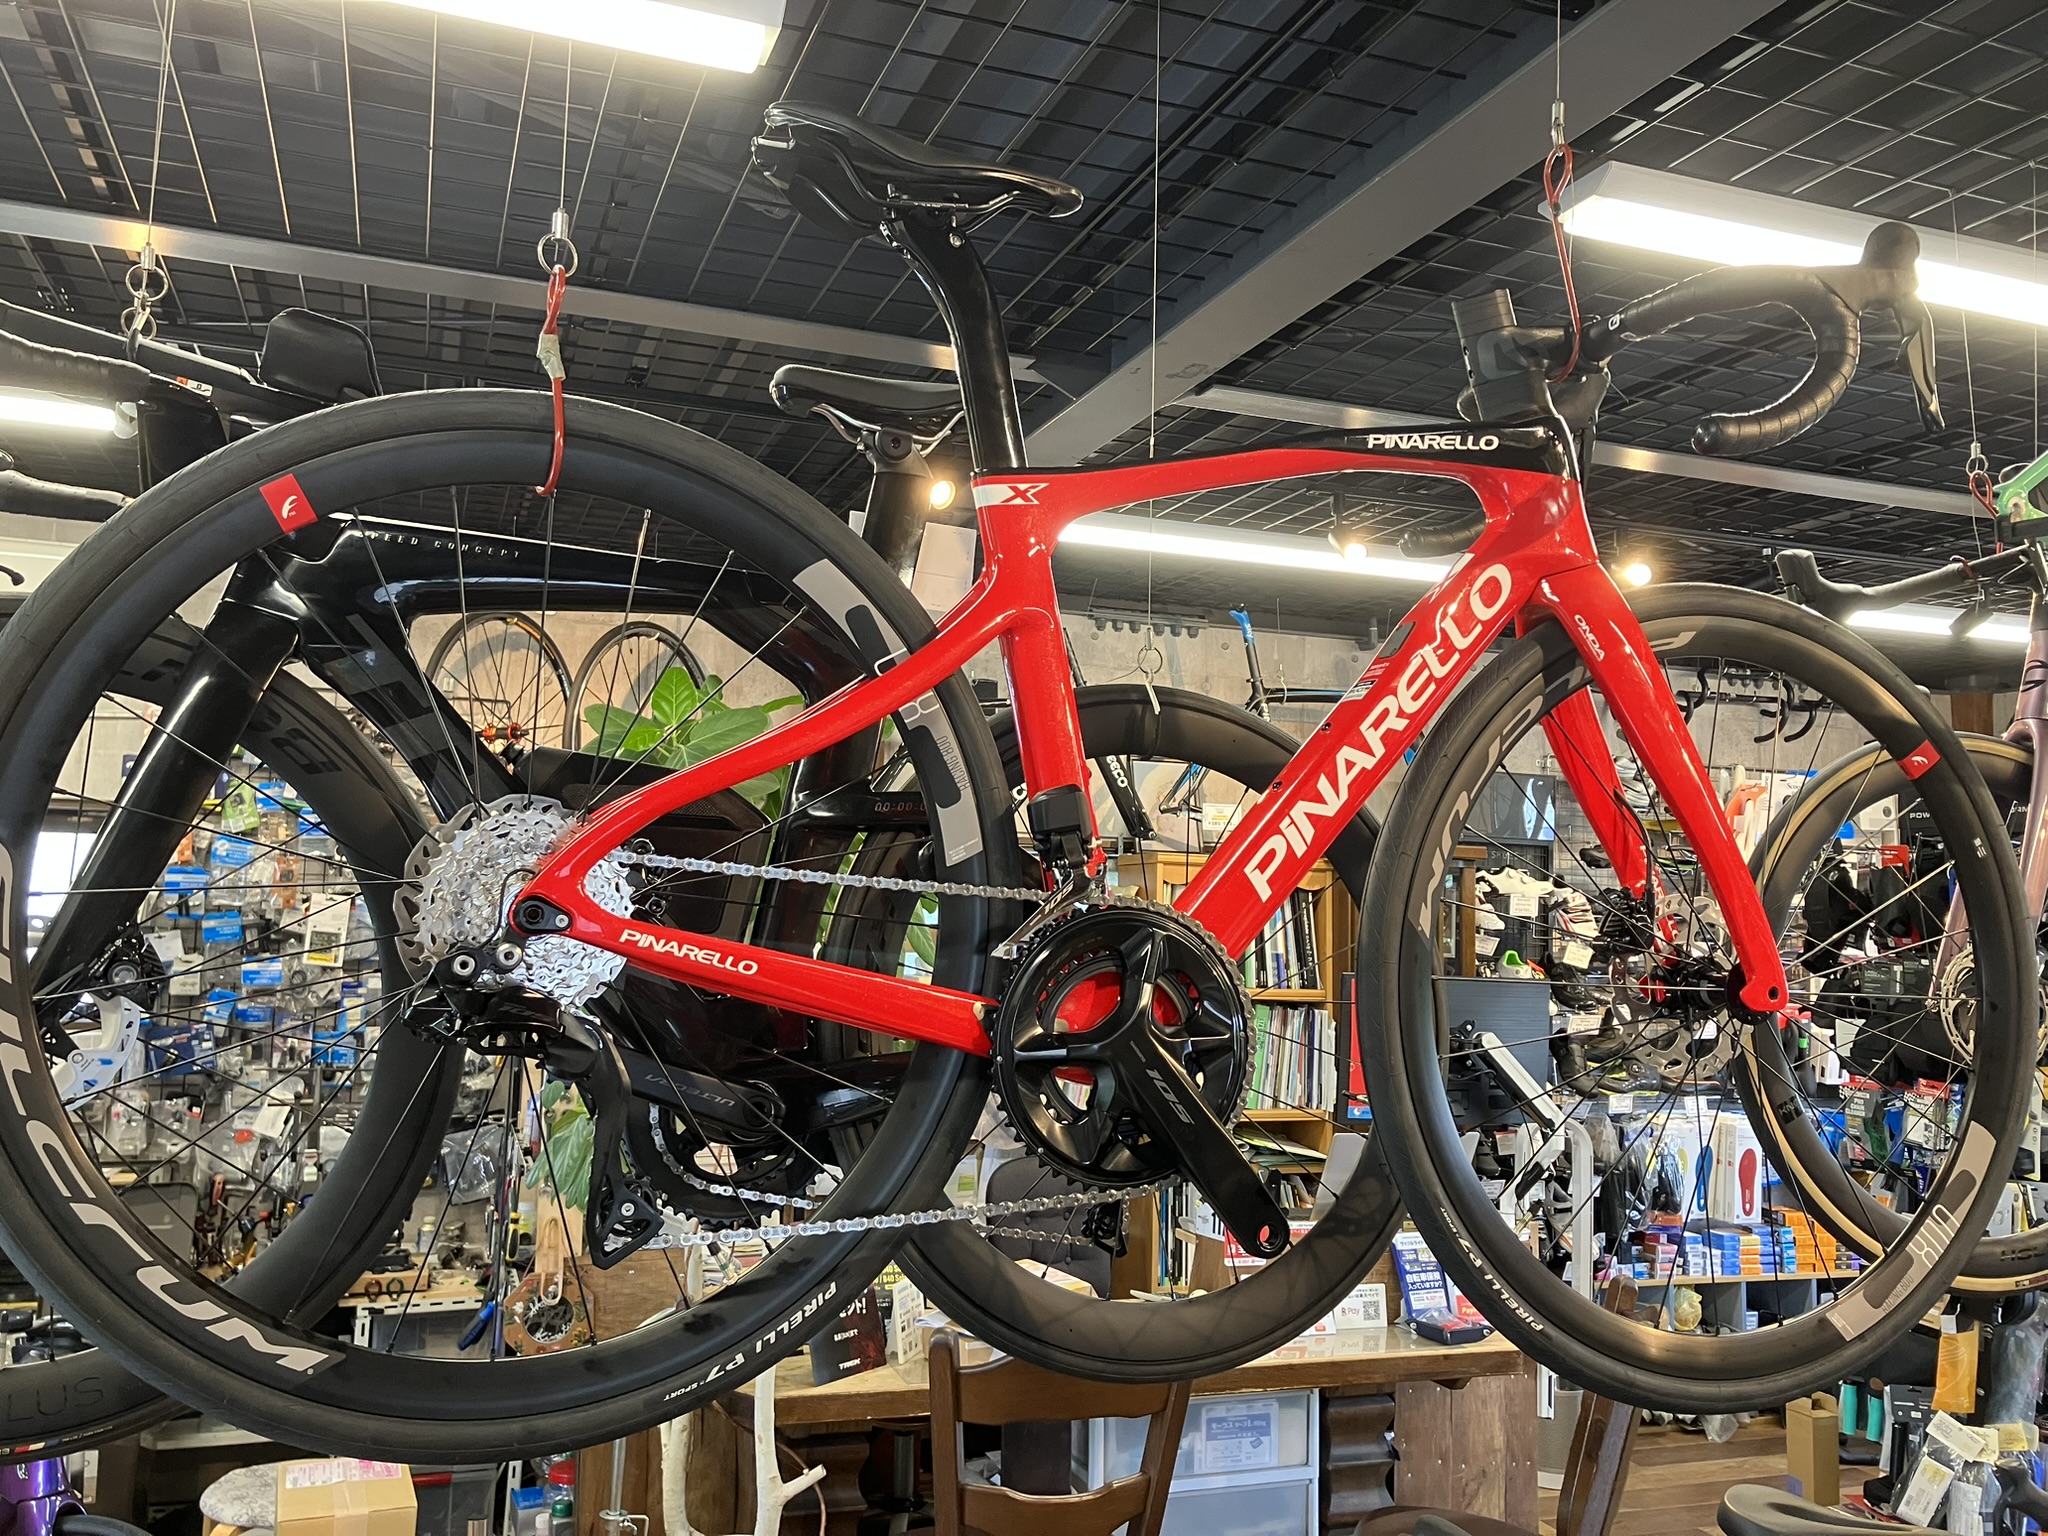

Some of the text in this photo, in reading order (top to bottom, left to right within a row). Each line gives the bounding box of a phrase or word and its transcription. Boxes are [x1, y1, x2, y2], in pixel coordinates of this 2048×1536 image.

[1367, 433, 1500, 451] PINARELLO
[434, 540, 520, 558] CONCEPT
[1574, 614, 1605, 662] ONDA
[1243, 563, 1512, 904] PINARELLO
[618, 928, 759, 976] PINARELLO
[1145, 1068, 1196, 1125] 105
[755, 1281, 837, 1354] PIRELLI
[1484, 1273, 1544, 1332] PIRELLI
[705, 1352, 746, 1384] P7
[838, 1358, 861, 1370] TREK
[663, 1382, 698, 1401] SPORT
